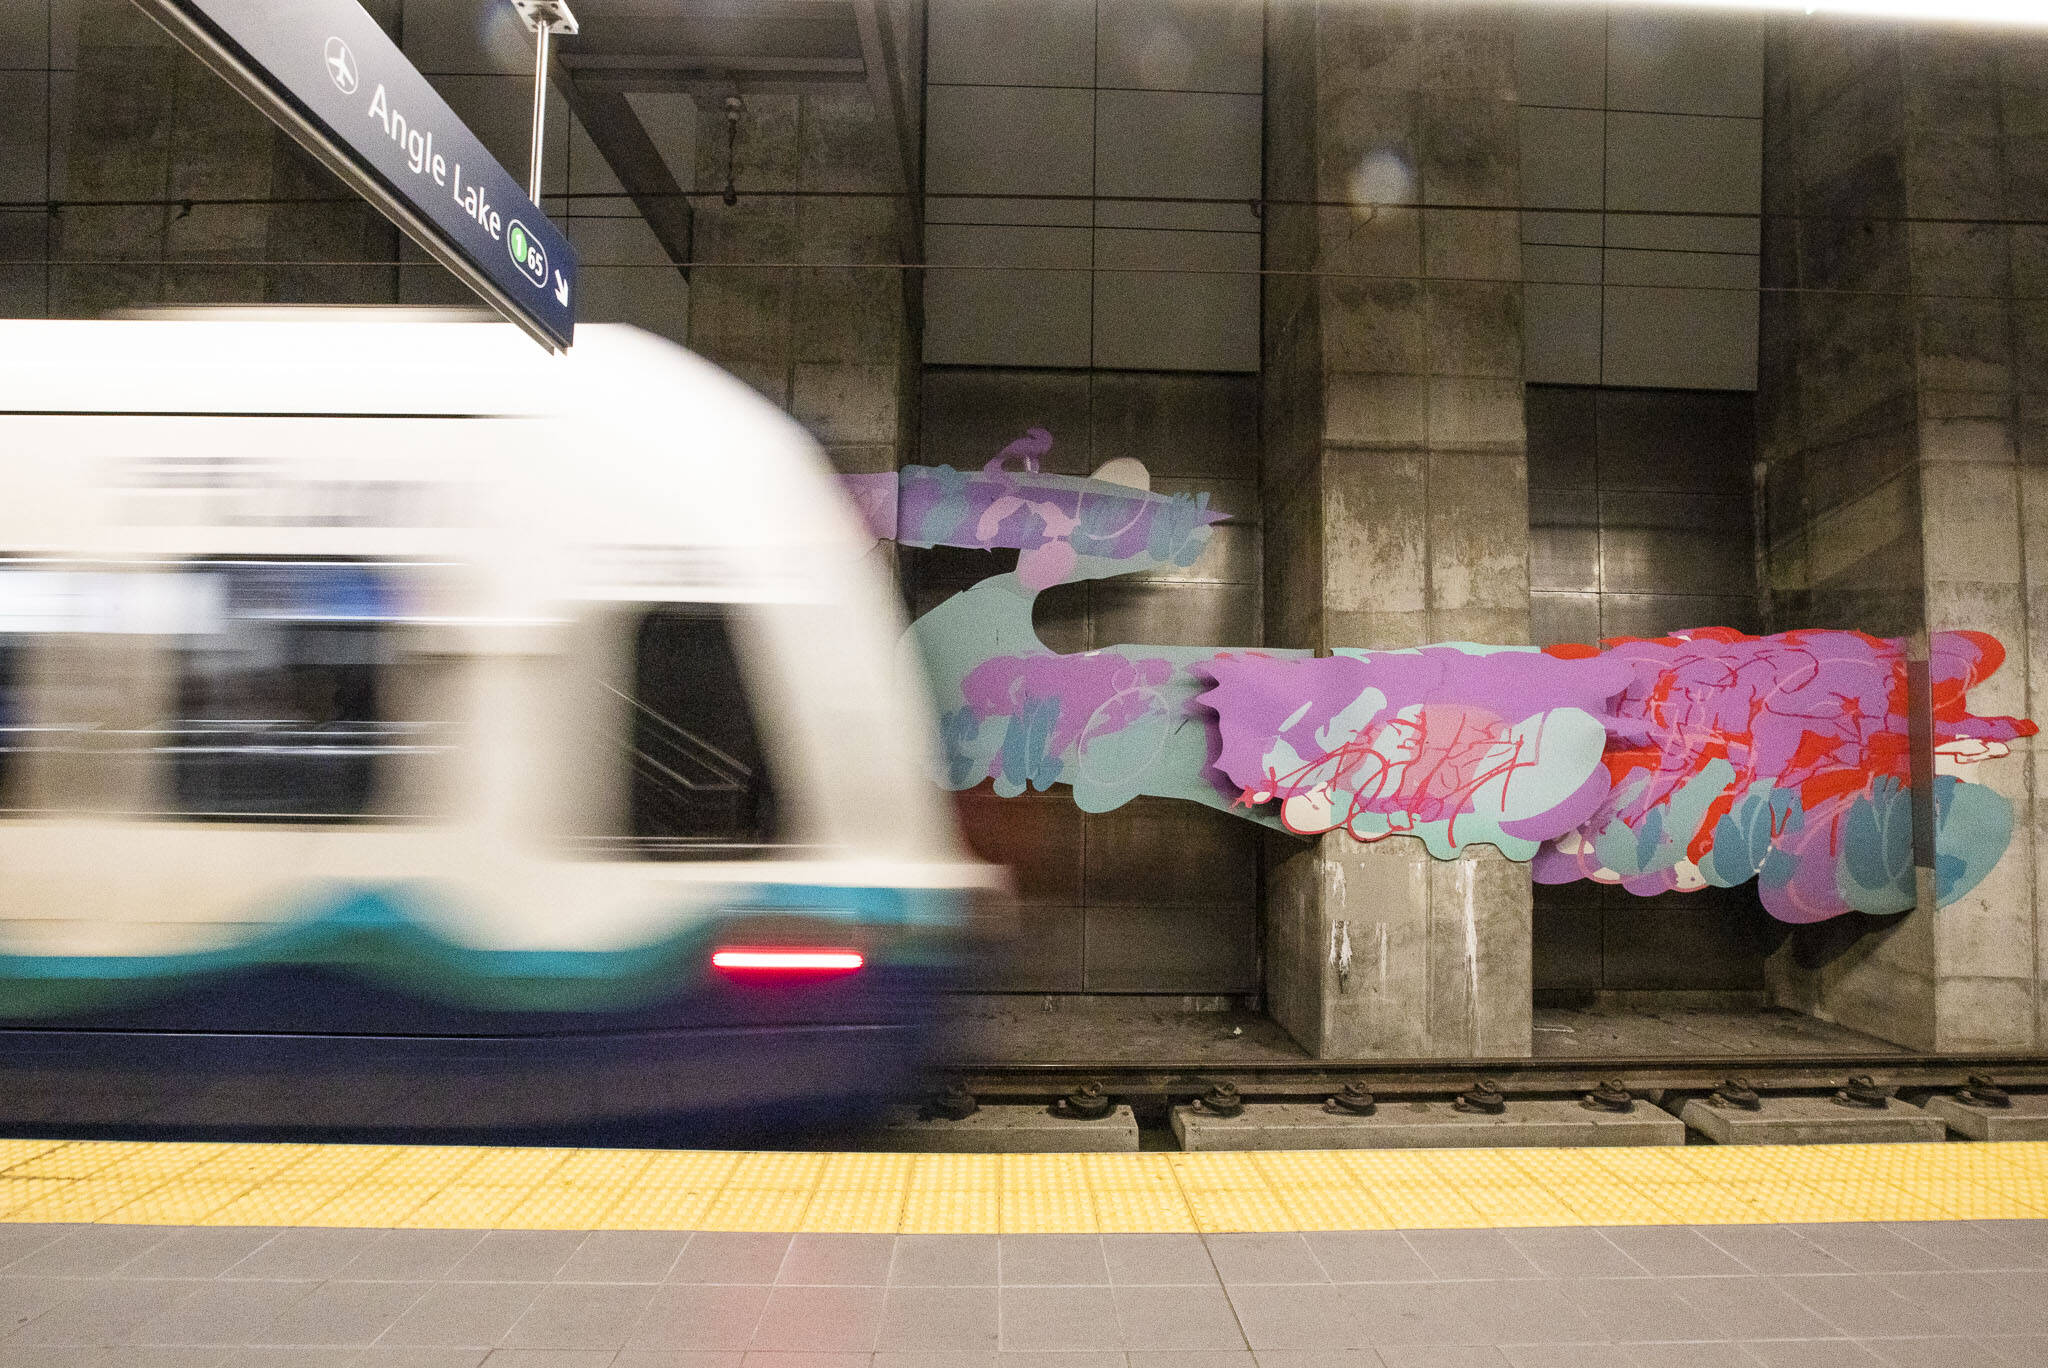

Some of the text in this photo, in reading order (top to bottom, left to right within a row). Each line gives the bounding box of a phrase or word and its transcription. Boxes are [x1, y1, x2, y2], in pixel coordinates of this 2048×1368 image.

[368, 83, 543, 277] Angle Lake 1 65
